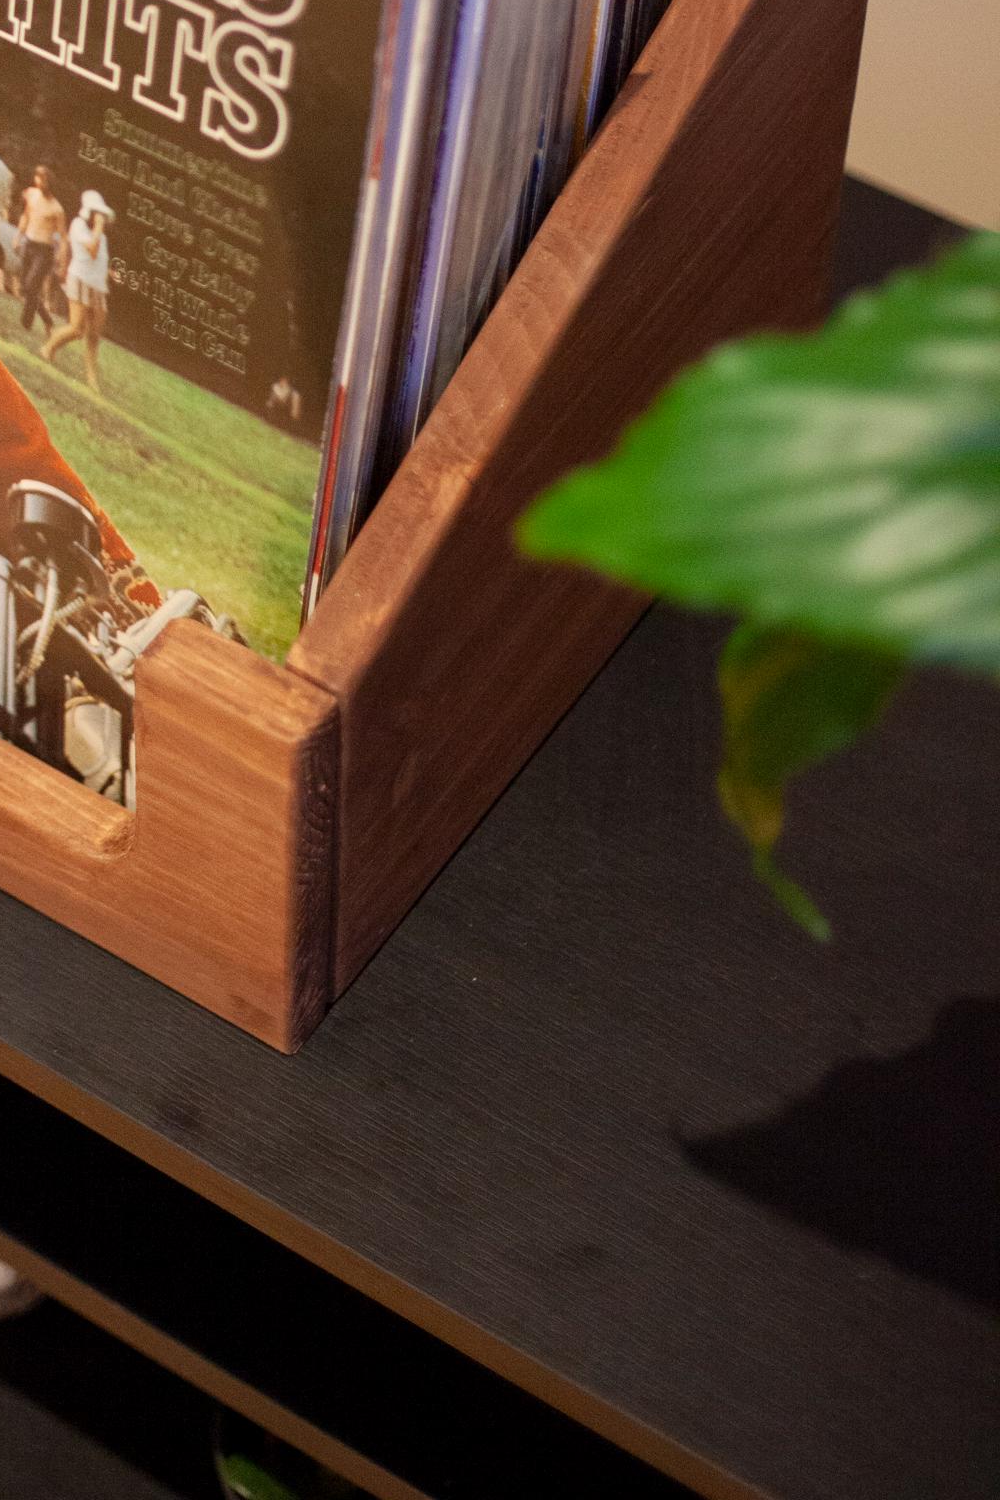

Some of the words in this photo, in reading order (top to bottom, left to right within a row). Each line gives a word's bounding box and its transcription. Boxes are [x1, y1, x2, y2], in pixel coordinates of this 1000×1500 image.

[78, 132, 131, 180] Ball
[133, 158, 185, 207] And
[109, 255, 150, 298] Get
[143, 235, 189, 281] Cry
[189, 256, 257, 314] Baby
[152, 305, 197, 350] You
[200, 330, 247, 375] Can
